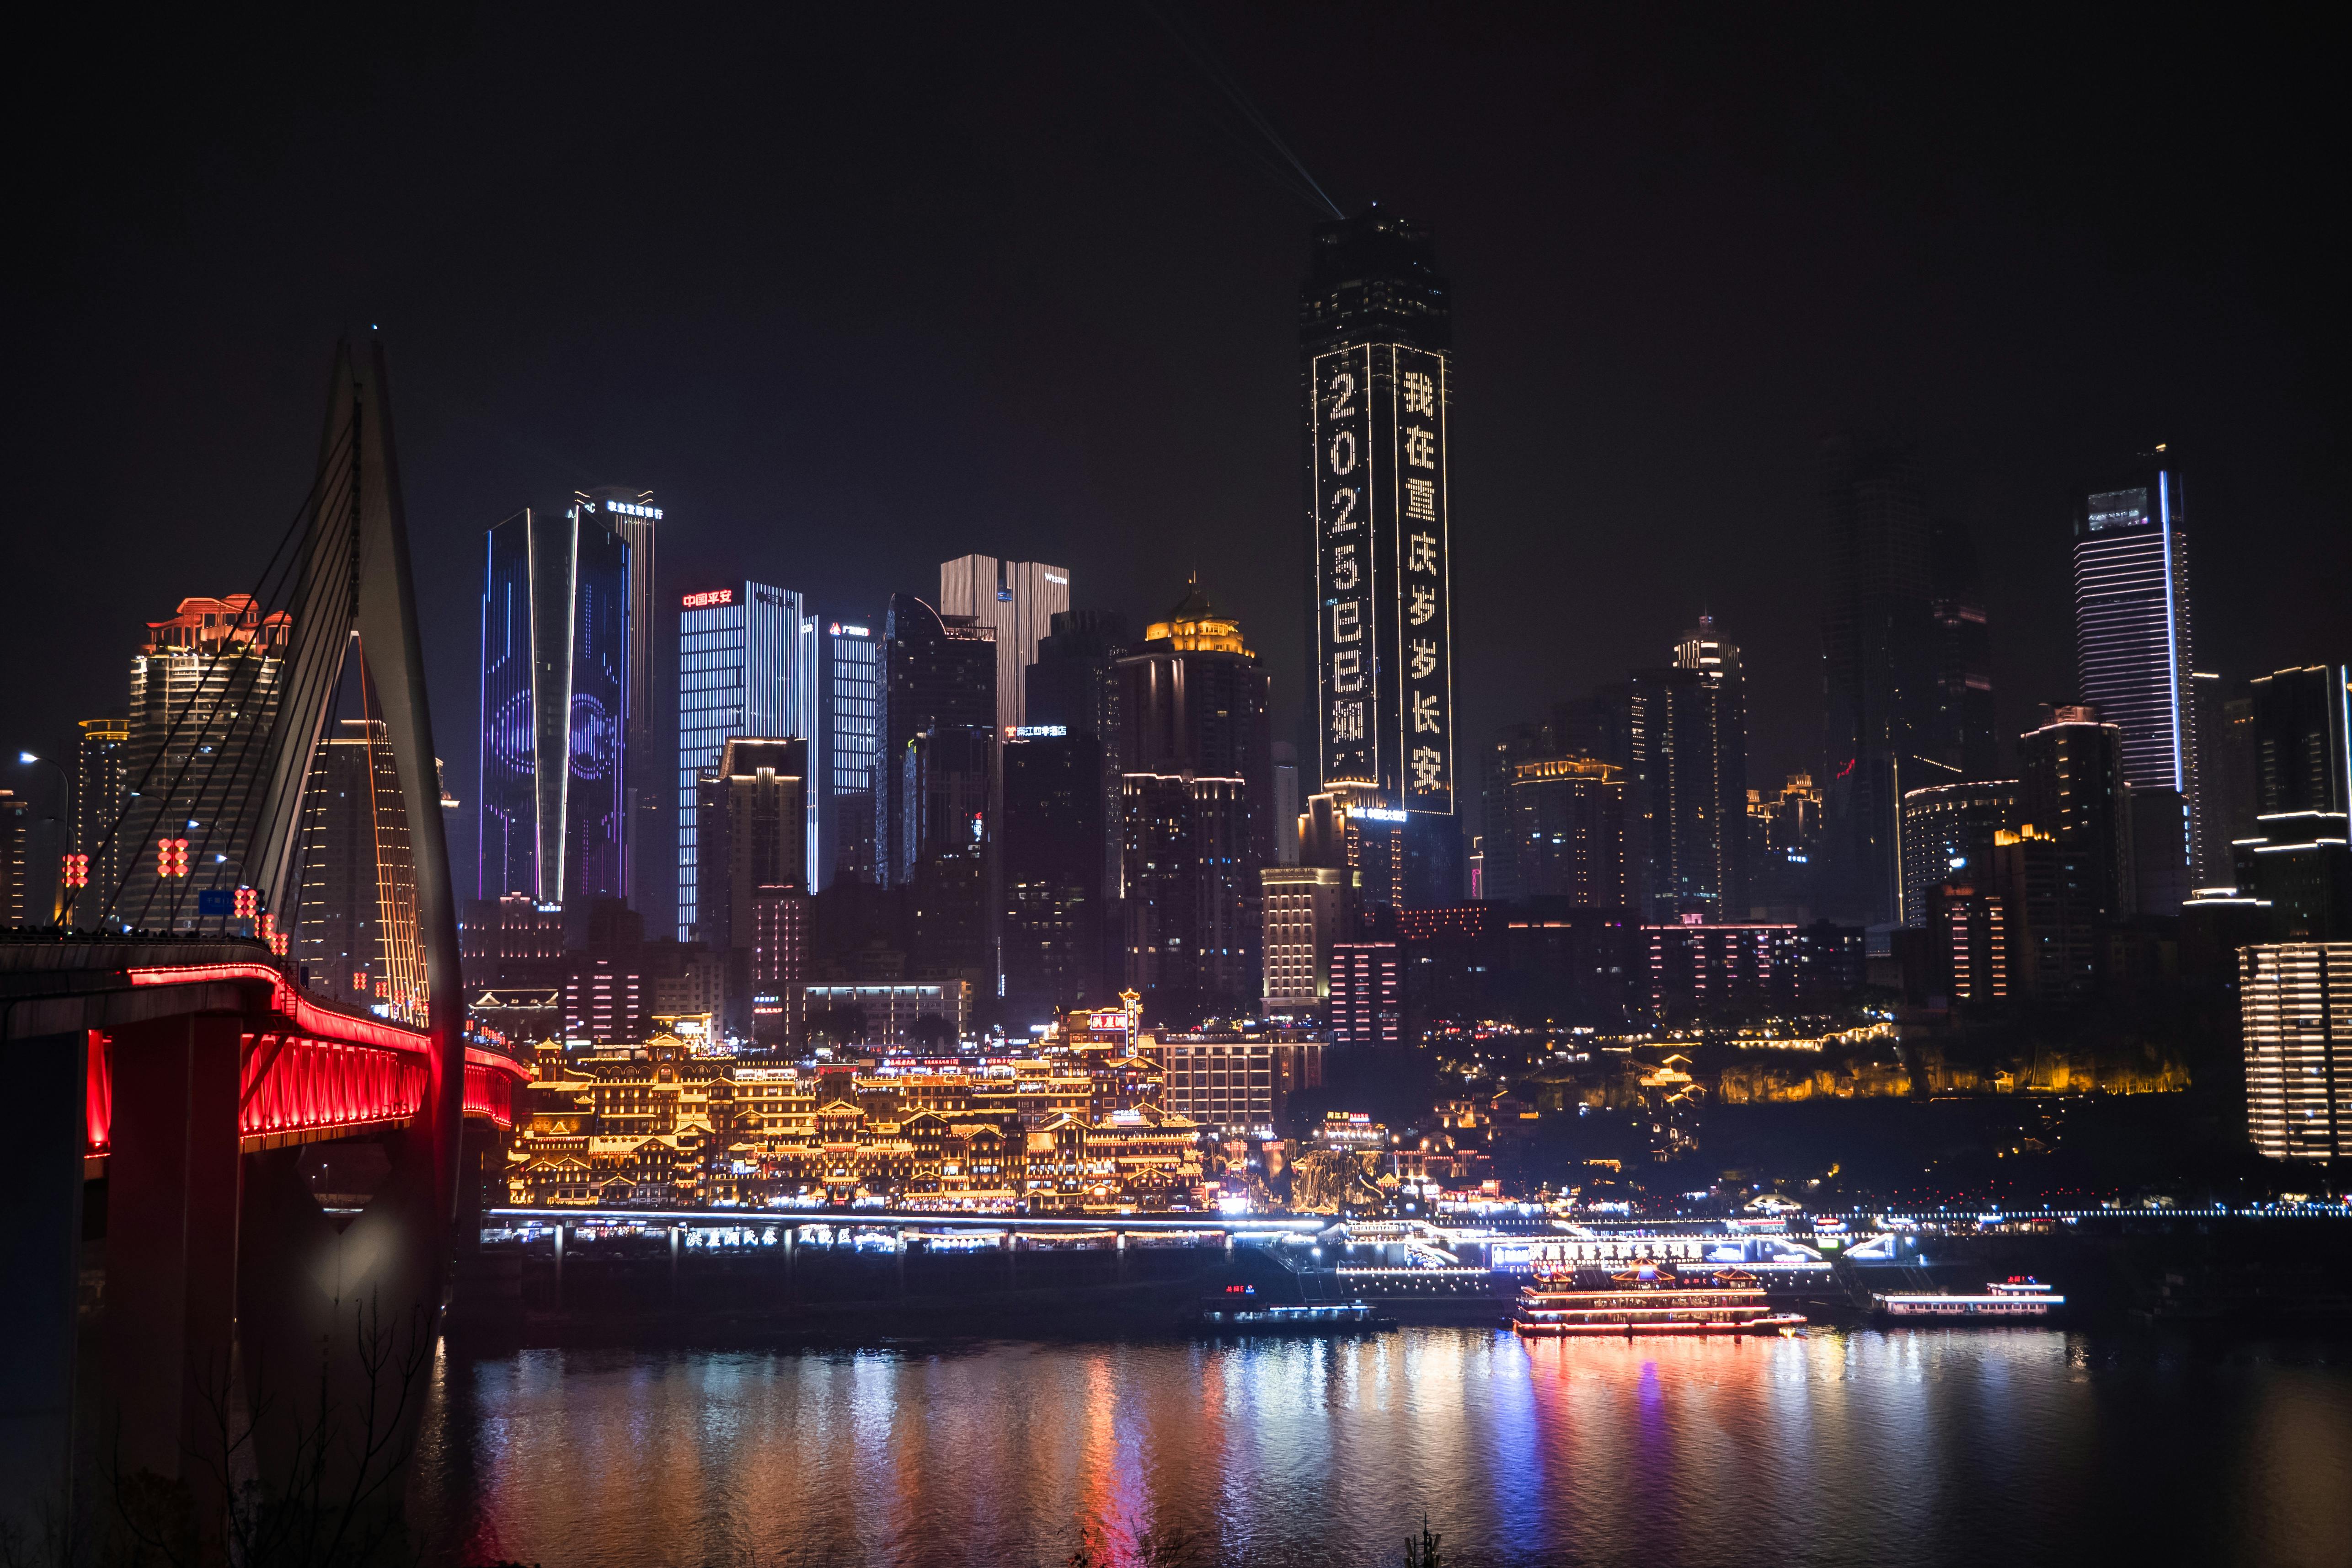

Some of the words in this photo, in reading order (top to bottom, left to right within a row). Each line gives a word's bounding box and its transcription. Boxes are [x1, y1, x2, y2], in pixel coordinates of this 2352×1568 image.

[1045, 573, 1067, 585] WESTIN
[683, 590, 732, 607] 中国平安
[1016, 726, 1067, 736] 两江四季酒店
[1092, 1016, 1126, 1028] 洪崖洞
